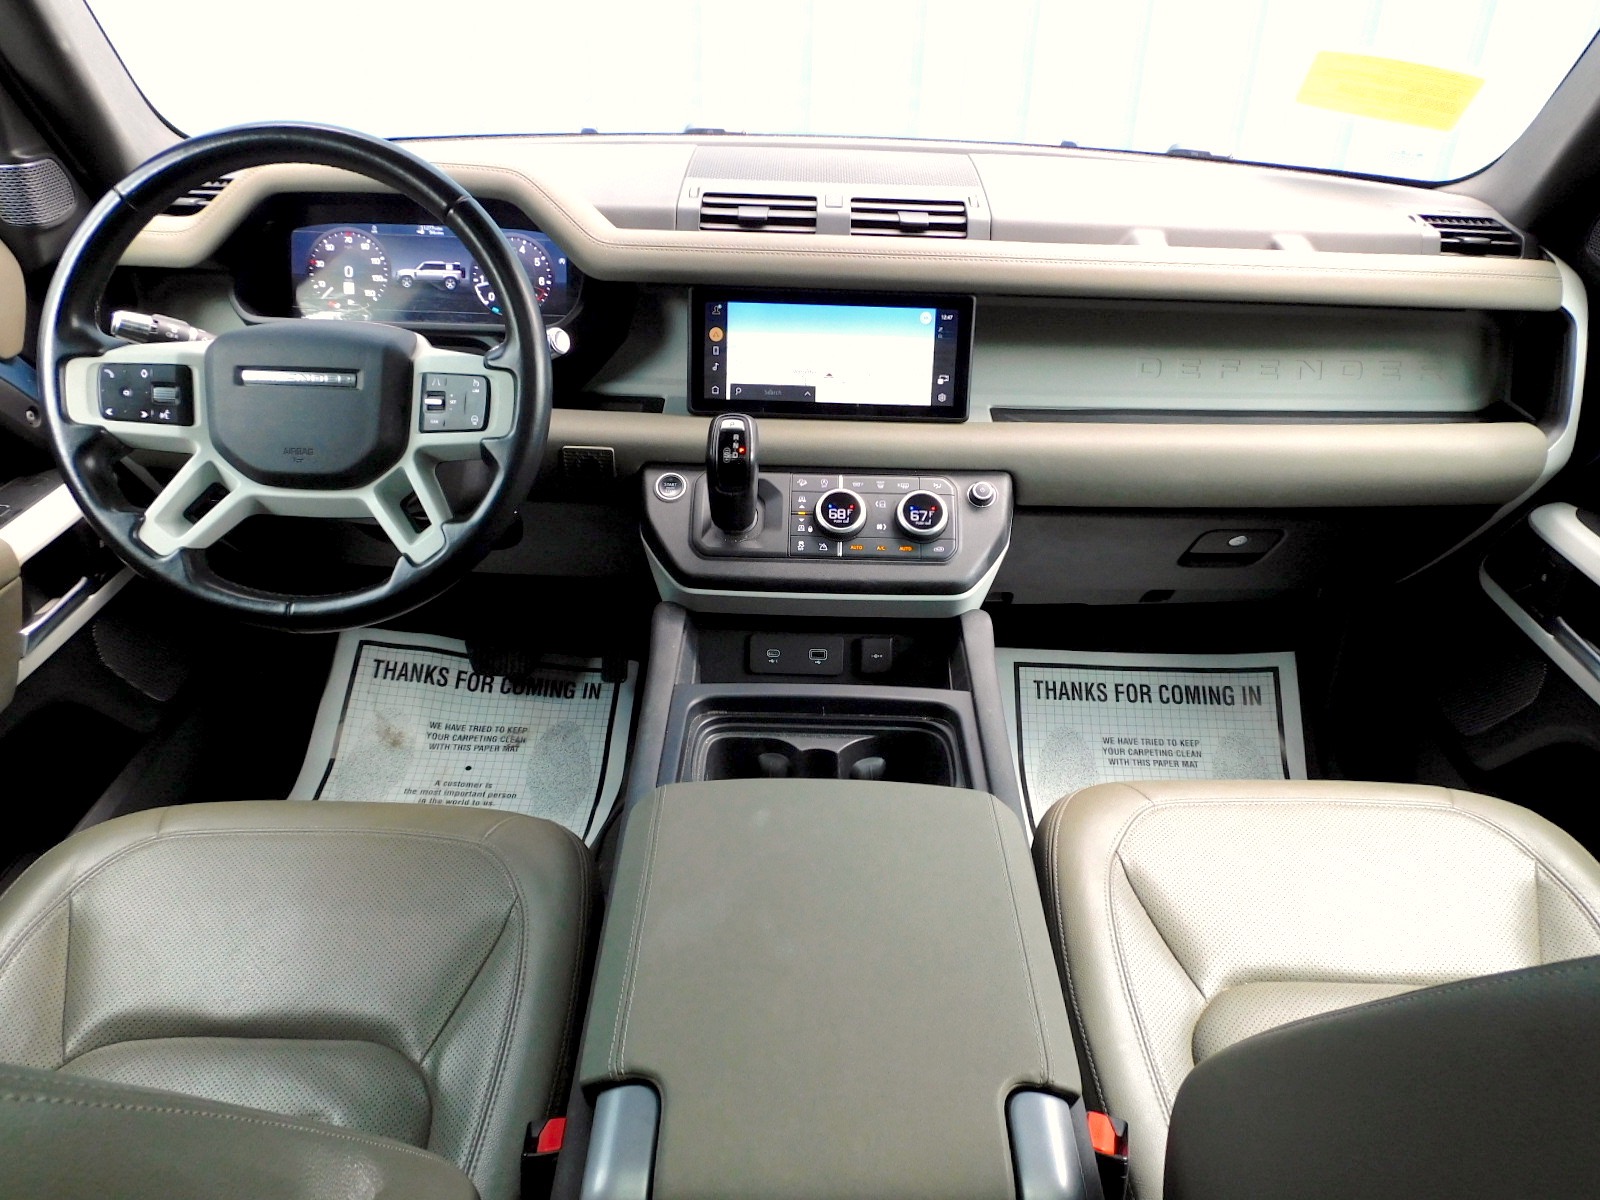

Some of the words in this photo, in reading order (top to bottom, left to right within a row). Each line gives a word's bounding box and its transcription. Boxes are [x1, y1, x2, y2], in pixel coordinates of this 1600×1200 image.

[519, 245, 526, 254] 4
[534, 257, 541, 267] 5
[343, 265, 354, 278] 0
[538, 276, 545, 286] 6
[1136, 357, 1447, 383] DEFENDER
[828, 508, 847, 520] 68
[910, 510, 928, 521] 67
[373, 658, 449, 687] THANKS
[455, 669, 495, 694] FOR
[582, 682, 602, 700] IN
[1033, 680, 1108, 703] THANKS
[1114, 683, 1153, 704] FOR
[1158, 684, 1235, 706] COMING
[1242, 685, 1262, 706] IN
[430, 721, 441, 730] WE
[445, 723, 466, 732] HAVE
[469, 724, 492, 733] TRIED
[495, 725, 505, 733] TO
[507, 726, 528, 734] KEEP
[427, 731, 450, 741] YOUR
[452, 734, 498, 743] CARPETING
[1103, 736, 1115, 745] WE
[1117, 737, 1139, 746] HAVE
[1141, 738, 1165, 747] TRIED
[1167, 739, 1177, 747] TO
[1180, 739, 1200, 748] KEEP
[429, 743, 451, 751] WITH
[454, 743, 471, 752] THIS
[1102, 747, 1126, 756] YOUR
[1128, 748, 1174, 757] CARPETING
[1176, 749, 1202, 758] CLEAN
[1108, 758, 1130, 767] WITH
[1132, 759, 1151, 767] THIS
[1153, 759, 1179, 768] PAPER
[1182, 760, 1199, 769] MAT
[443, 780, 483, 789] customer
[403, 787, 418, 795] the
[420, 788, 442, 796] most
[444, 788, 486, 798] important
[487, 791, 518, 800] person
[445, 798, 470, 806] world
[472, 799, 481, 807] to
